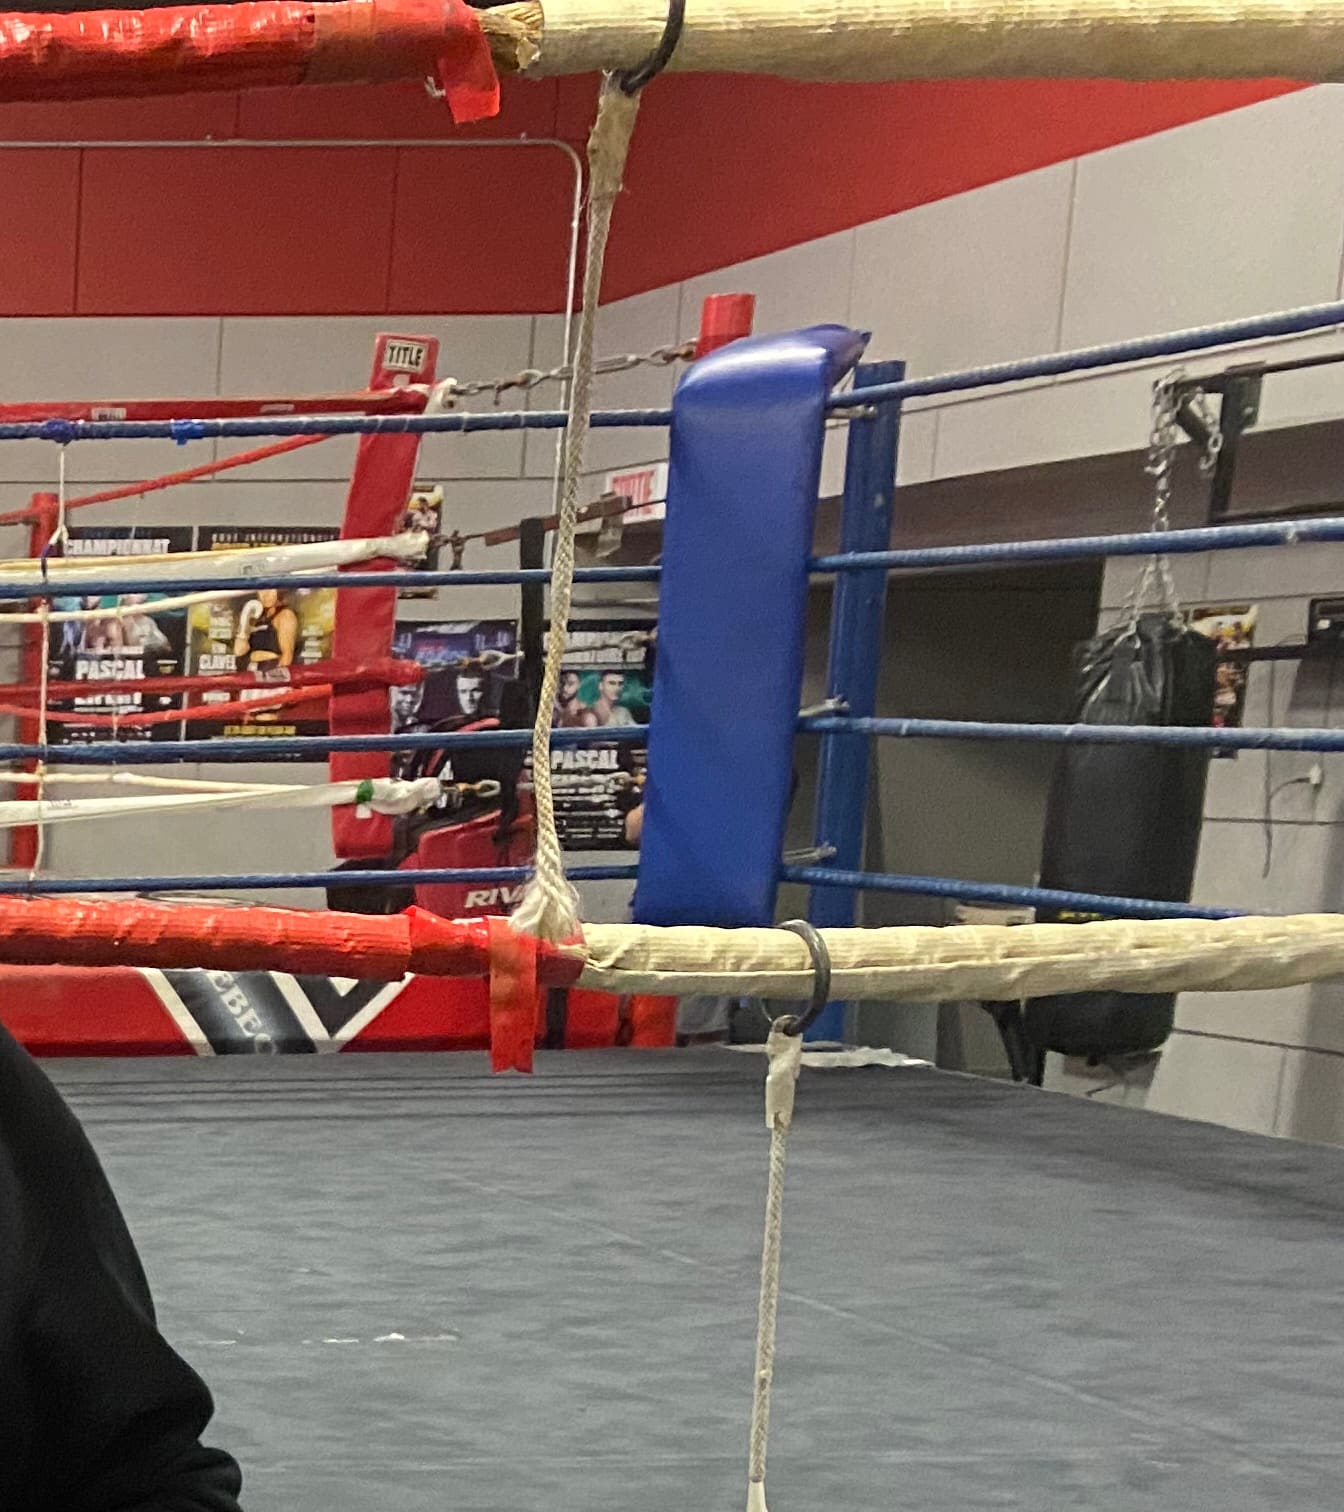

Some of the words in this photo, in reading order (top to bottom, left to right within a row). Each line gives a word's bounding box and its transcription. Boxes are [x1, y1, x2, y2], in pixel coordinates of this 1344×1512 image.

[388, 345, 423, 367] TITLE
[76, 660, 146, 680] PASCAL
[551, 749, 619, 769] PASCAL
